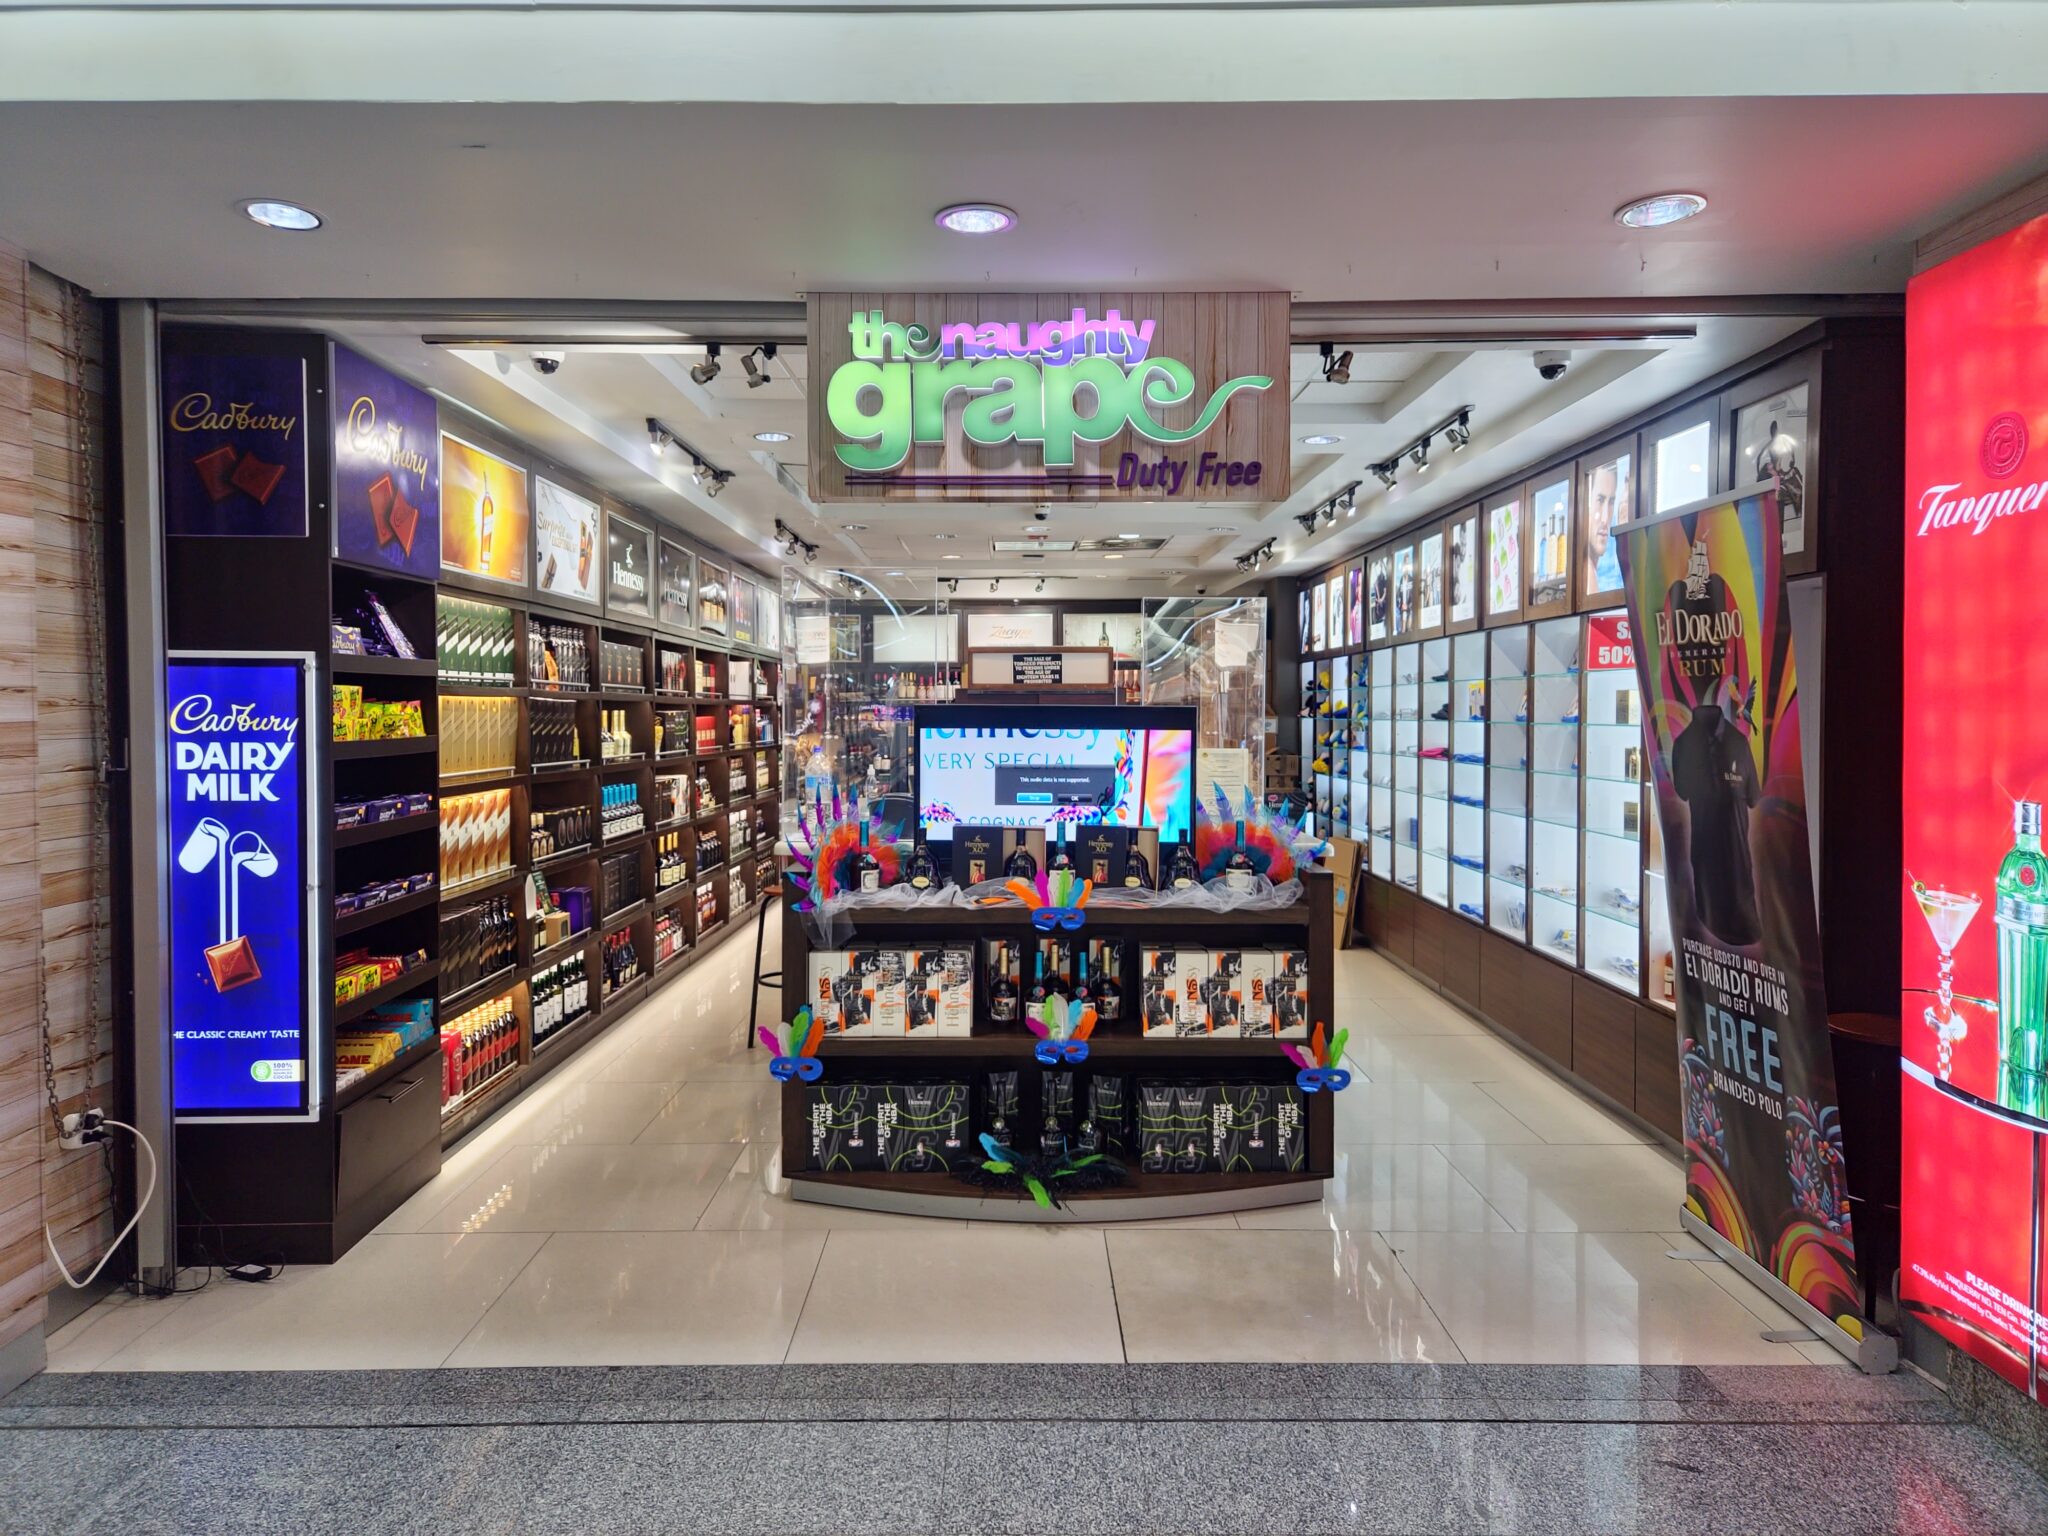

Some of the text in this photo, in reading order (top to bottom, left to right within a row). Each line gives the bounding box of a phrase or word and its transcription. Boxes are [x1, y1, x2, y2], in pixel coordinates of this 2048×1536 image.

[849, 308, 1156, 366] the naughty
[170, 392, 296, 440] Cadbury
[826, 357, 1274, 471] grape
[347, 396, 428, 491] Cadbury
[1116, 452, 1262, 495] Duty Free
[613, 561, 644, 597] Hennessy
[1656, 609, 1743, 645] EL DORADO
[1680, 659, 1726, 676] RUM
[170, 694, 299, 742] Cadbury
[176, 742, 295, 771] DAIRY
[924, 753, 1078, 770] VERY SPECIAL
[187, 773, 280, 801] MILK
[968, 816, 1038, 825] COGNAC
[1682, 937, 1713, 959] PURCHASE
[1743, 957, 1759, 974] AND
[1760, 963, 1776, 982] OVER
[1777, 971, 1786, 986] IN
[1685, 953, 1789, 1016] EL DORADO RUMS
[1719, 992, 1732, 1008] AND
[1733, 998, 1748, 1015] GET
[187, 1031, 225, 1039] CLASSIC
[228, 1030, 267, 1038] CREAMY
[270, 1030, 299, 1038] TASTE
[1704, 1002, 1784, 1094] FREE
[1713, 1070, 1783, 1121] BRANDED POLO
[820, 1123, 826, 1138] OF
[885, 1123, 891, 1138] OF
[1220, 1123, 1226, 1139] OF
[1285, 1122, 1292, 1138] OF
[1965, 1270, 2001, 1301] PLEASE
[2002, 1292, 2034, 1321] DRINK
